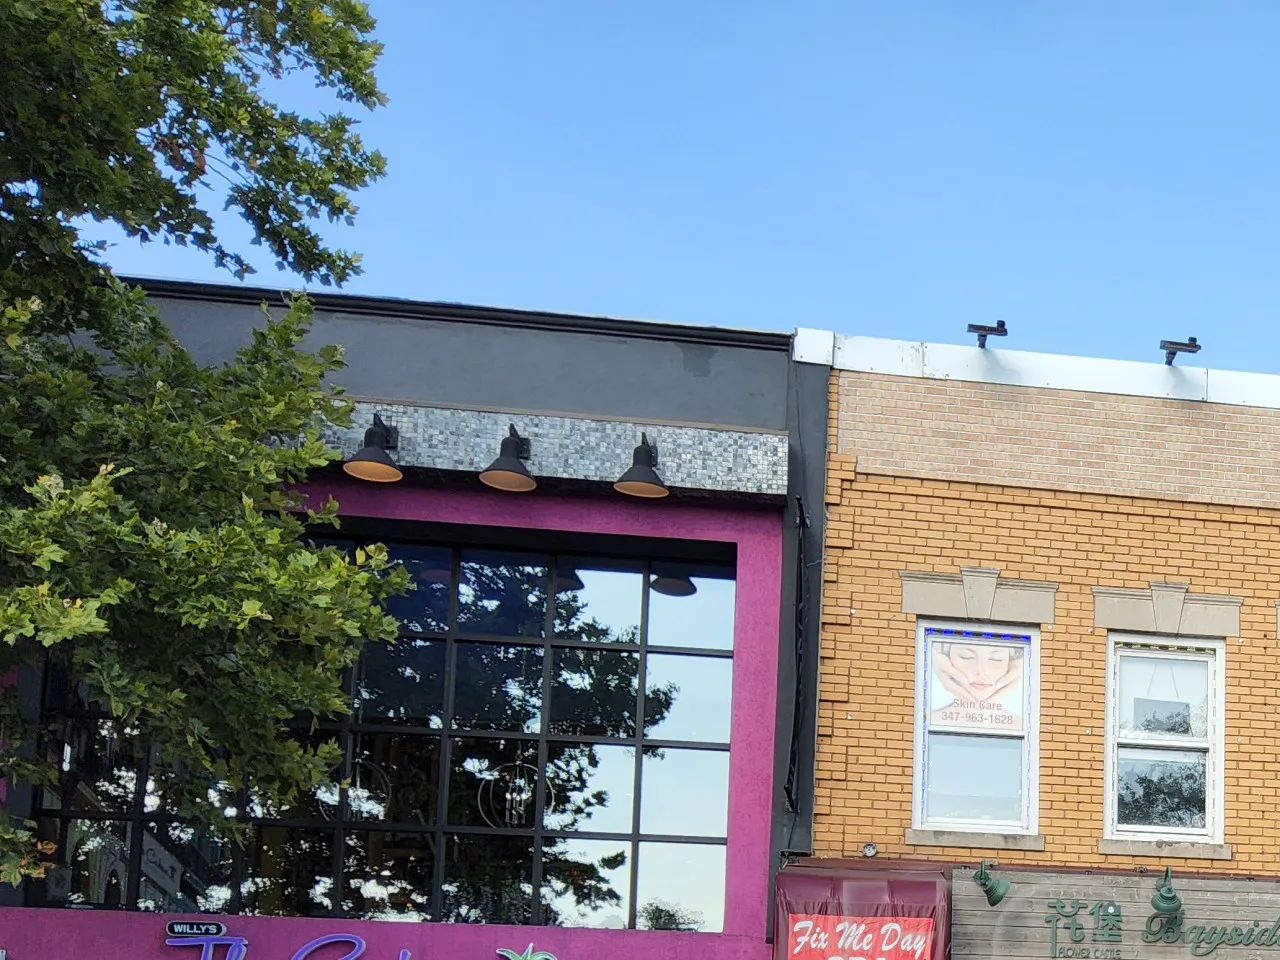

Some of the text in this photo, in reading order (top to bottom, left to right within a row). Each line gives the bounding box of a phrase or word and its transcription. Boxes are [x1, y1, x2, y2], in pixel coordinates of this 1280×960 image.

[953, 699, 1002, 711] Skin Care
[941, 711, 1013, 725] 347-963-1628
[173, 923, 218, 935] WILLY'S
[793, 921, 927, 960] Fix Me Day
[1093, 948, 1122, 960] CASTLE
